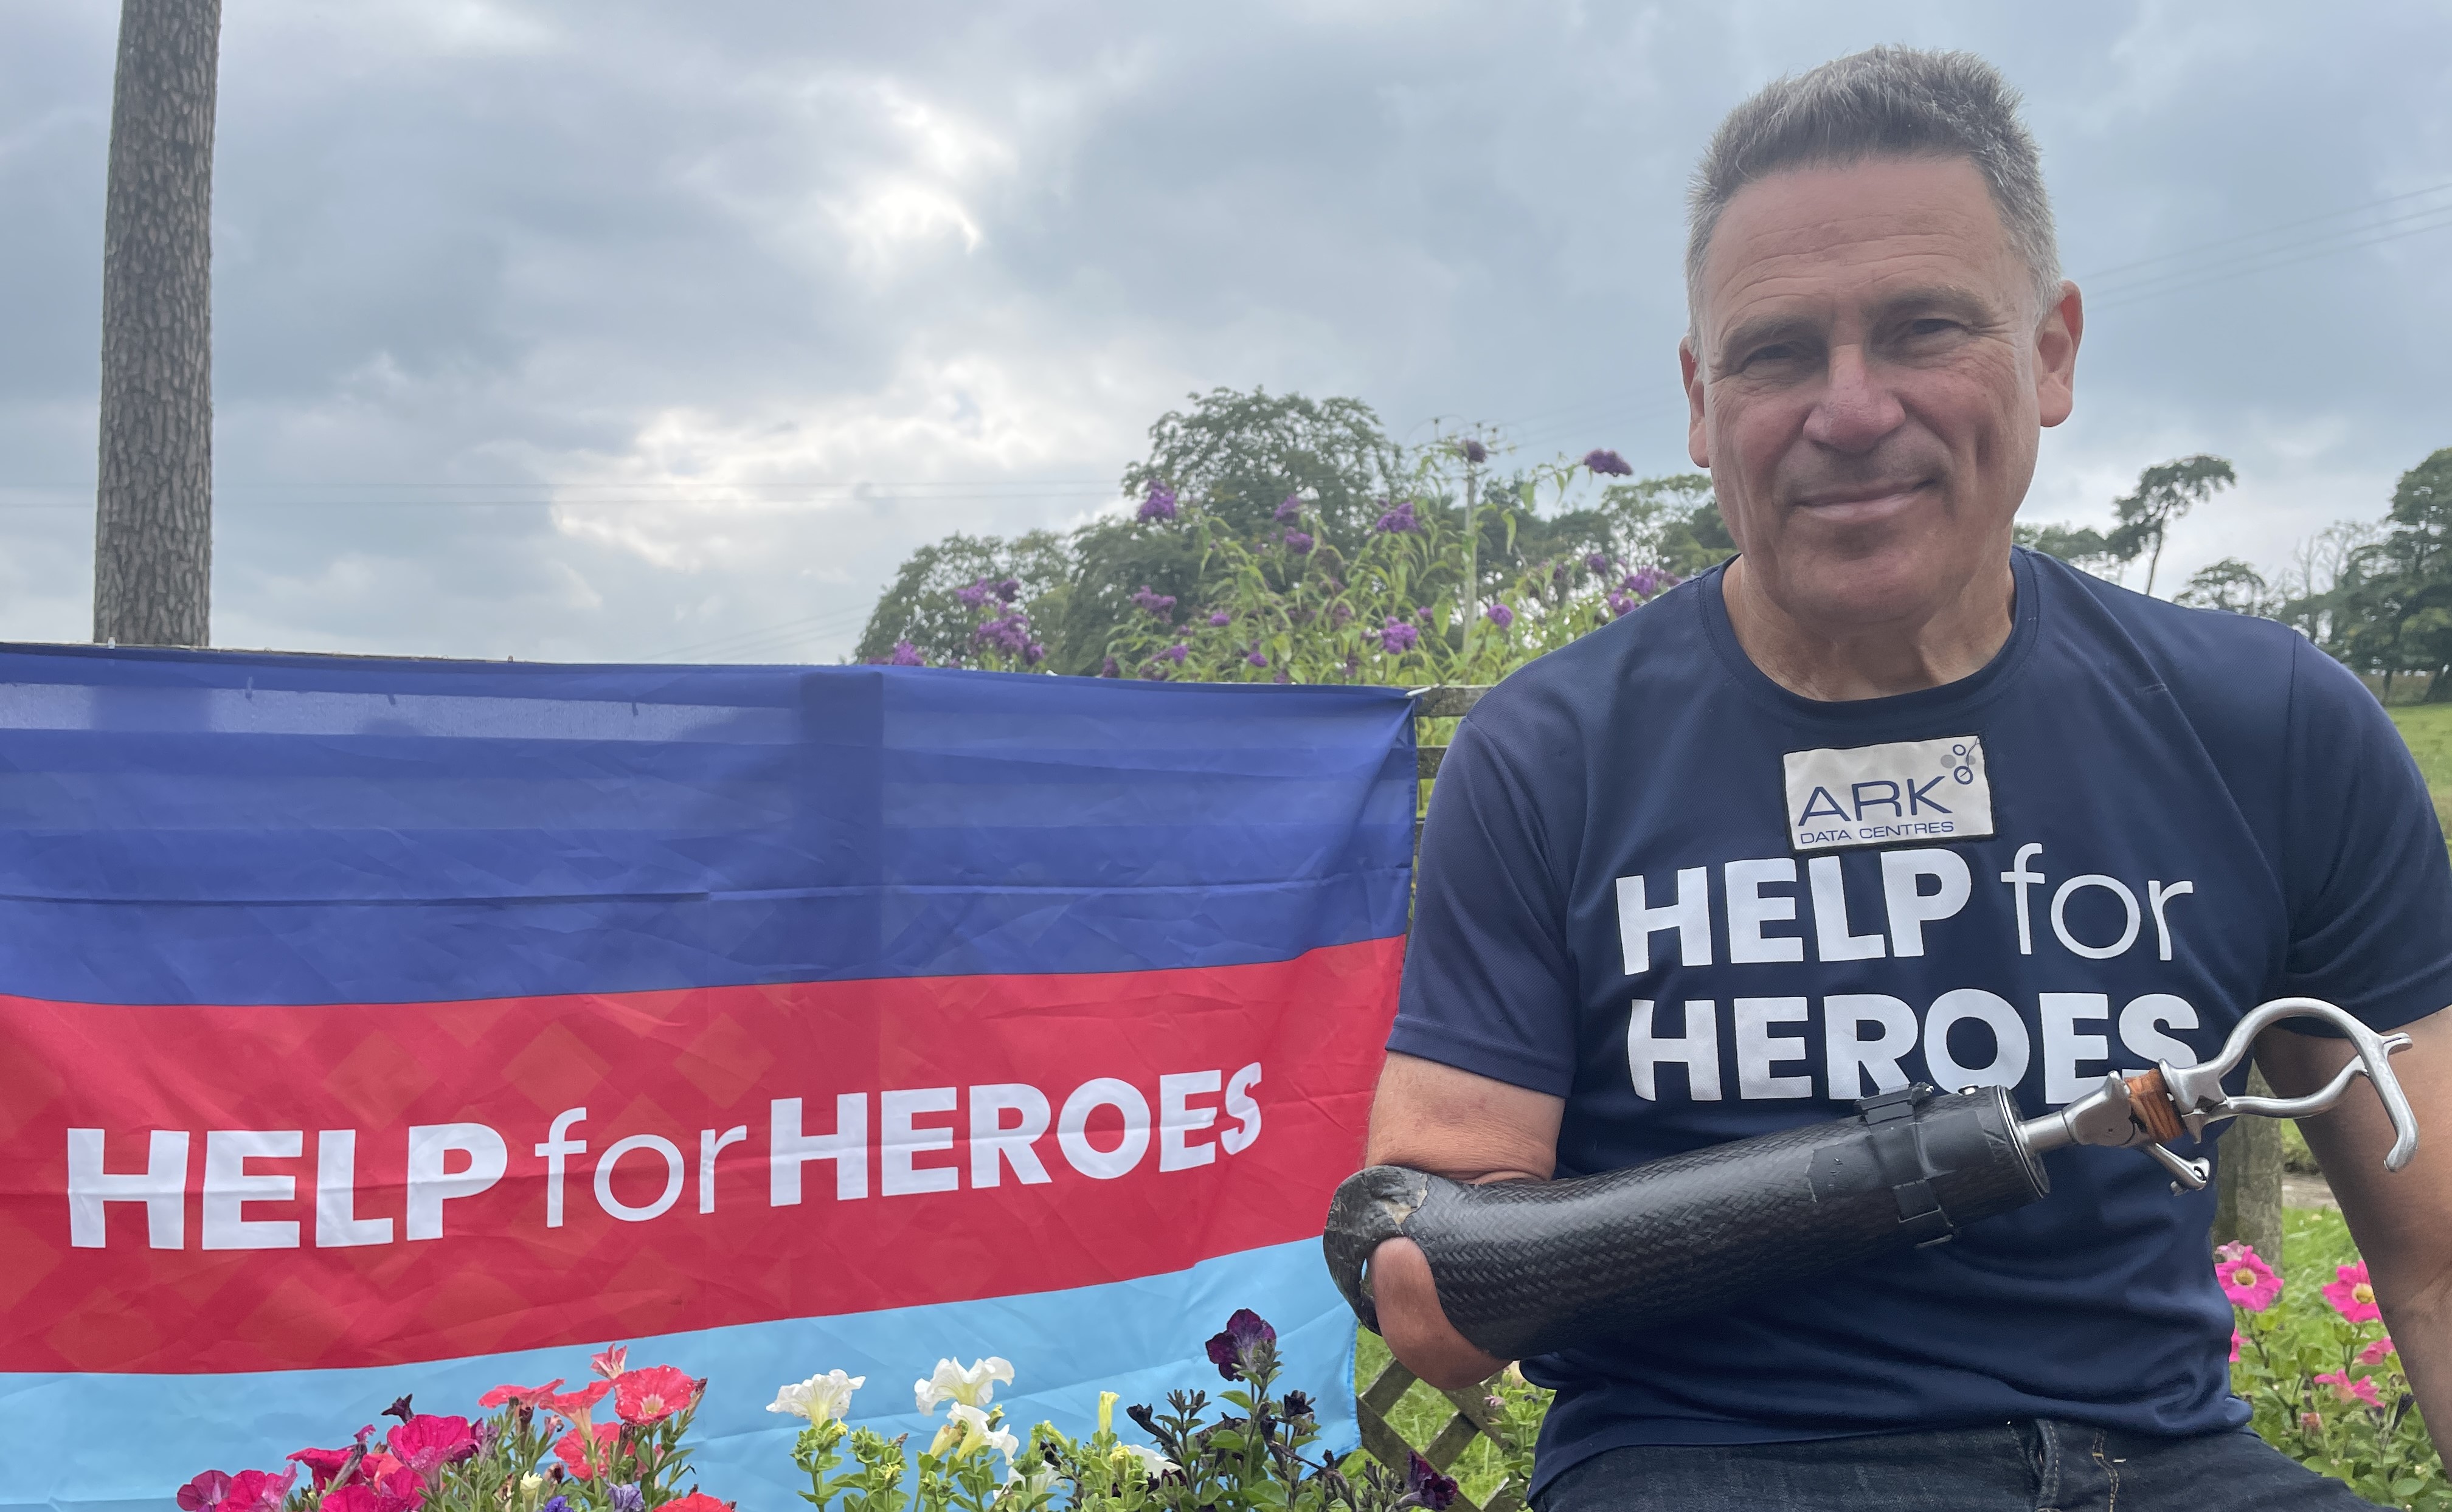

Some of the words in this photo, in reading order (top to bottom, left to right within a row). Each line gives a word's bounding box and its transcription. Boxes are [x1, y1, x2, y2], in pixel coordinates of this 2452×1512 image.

[1798, 776, 1953, 827] ARK
[1801, 830, 1852, 844] DATA
[1860, 821, 1954, 839] CENTRES
[1616, 847, 1972, 976] HELP
[2001, 843, 2193, 961] for
[1627, 989, 2199, 1104] HEROES
[66, 1122, 508, 1251] HELP
[535, 1106, 747, 1229] for
[769, 1062, 1262, 1207] HEROES
